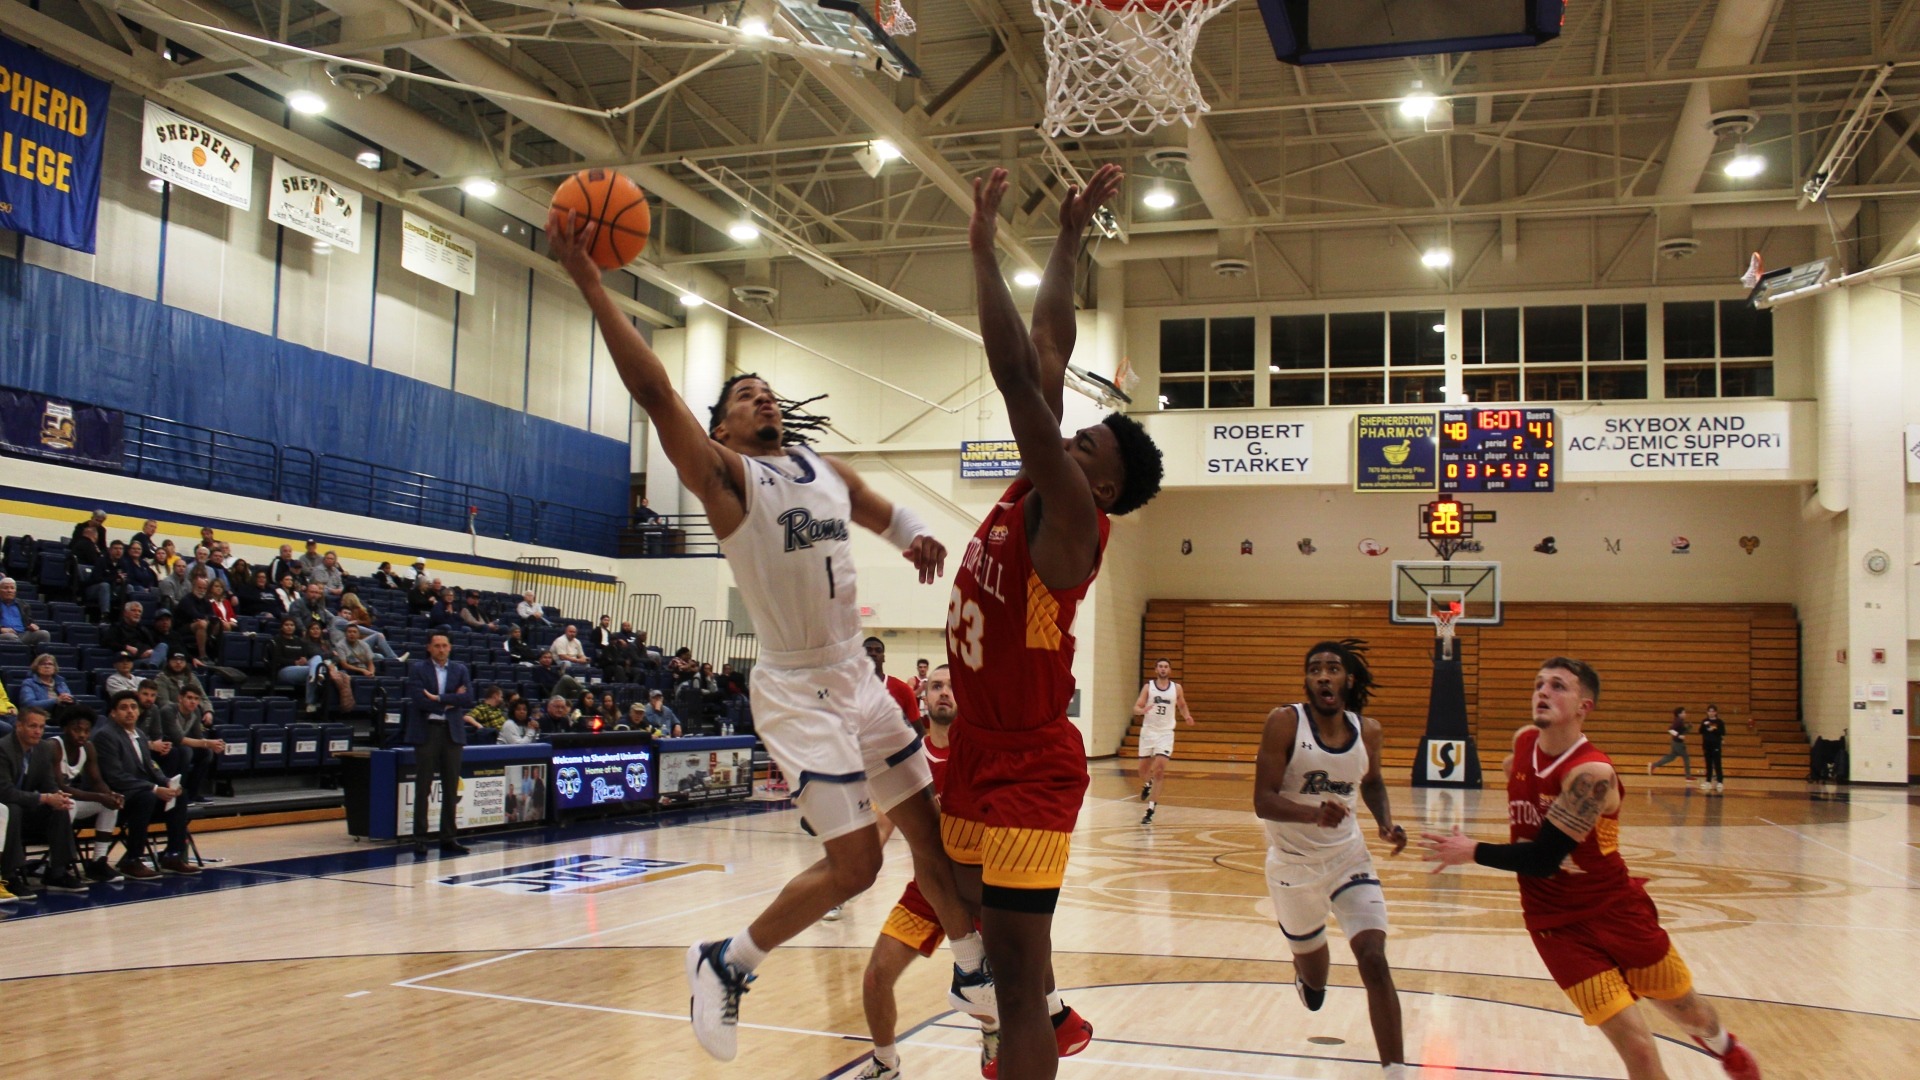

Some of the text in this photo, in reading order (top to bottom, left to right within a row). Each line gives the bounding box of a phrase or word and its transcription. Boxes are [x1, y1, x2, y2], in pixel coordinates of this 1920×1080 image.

[156, 123, 240, 173] SHEPHERD
[1360, 415, 1434, 426] SHEPHERDSTOWN
[1444, 413, 1464, 421] Home
[1478, 410, 1522, 430] 16:07
[1526, 411, 1551, 420] Guests
[1213, 424, 1305, 440] ROBERT
[1360, 427, 1433, 438] PHARMACY
[1443, 422, 1468, 441] 48
[1528, 421, 1553, 440] 41
[1605, 416, 1745, 433] SKYBOX AND
[1247, 441, 1269, 456] G.
[1485, 435, 1523, 450] period 2
[1569, 433, 1782, 451] ACADEMIC SUPPORT
[1207, 457, 1309, 473] STARKEY
[1630, 452, 1719, 468] CENTER
[1447, 463, 1458, 478] 0
[1466, 463, 1477, 478] 3
[1516, 463, 1528, 478] 2
[1537, 463, 1550, 478] 2
[777, 507, 849, 553] Rams
[1431, 511, 1460, 534] 26
[825, 556, 835, 599] 1
[948, 584, 985, 672] 23
[1156, 705, 1166, 715] 33
[552, 751, 649, 765] Welcome to Shepherd University
[585, 767, 603, 775] Home
[612, 765, 622, 773] the
[591, 776, 625, 804] Rams
[1299, 770, 1354, 796] Rams
